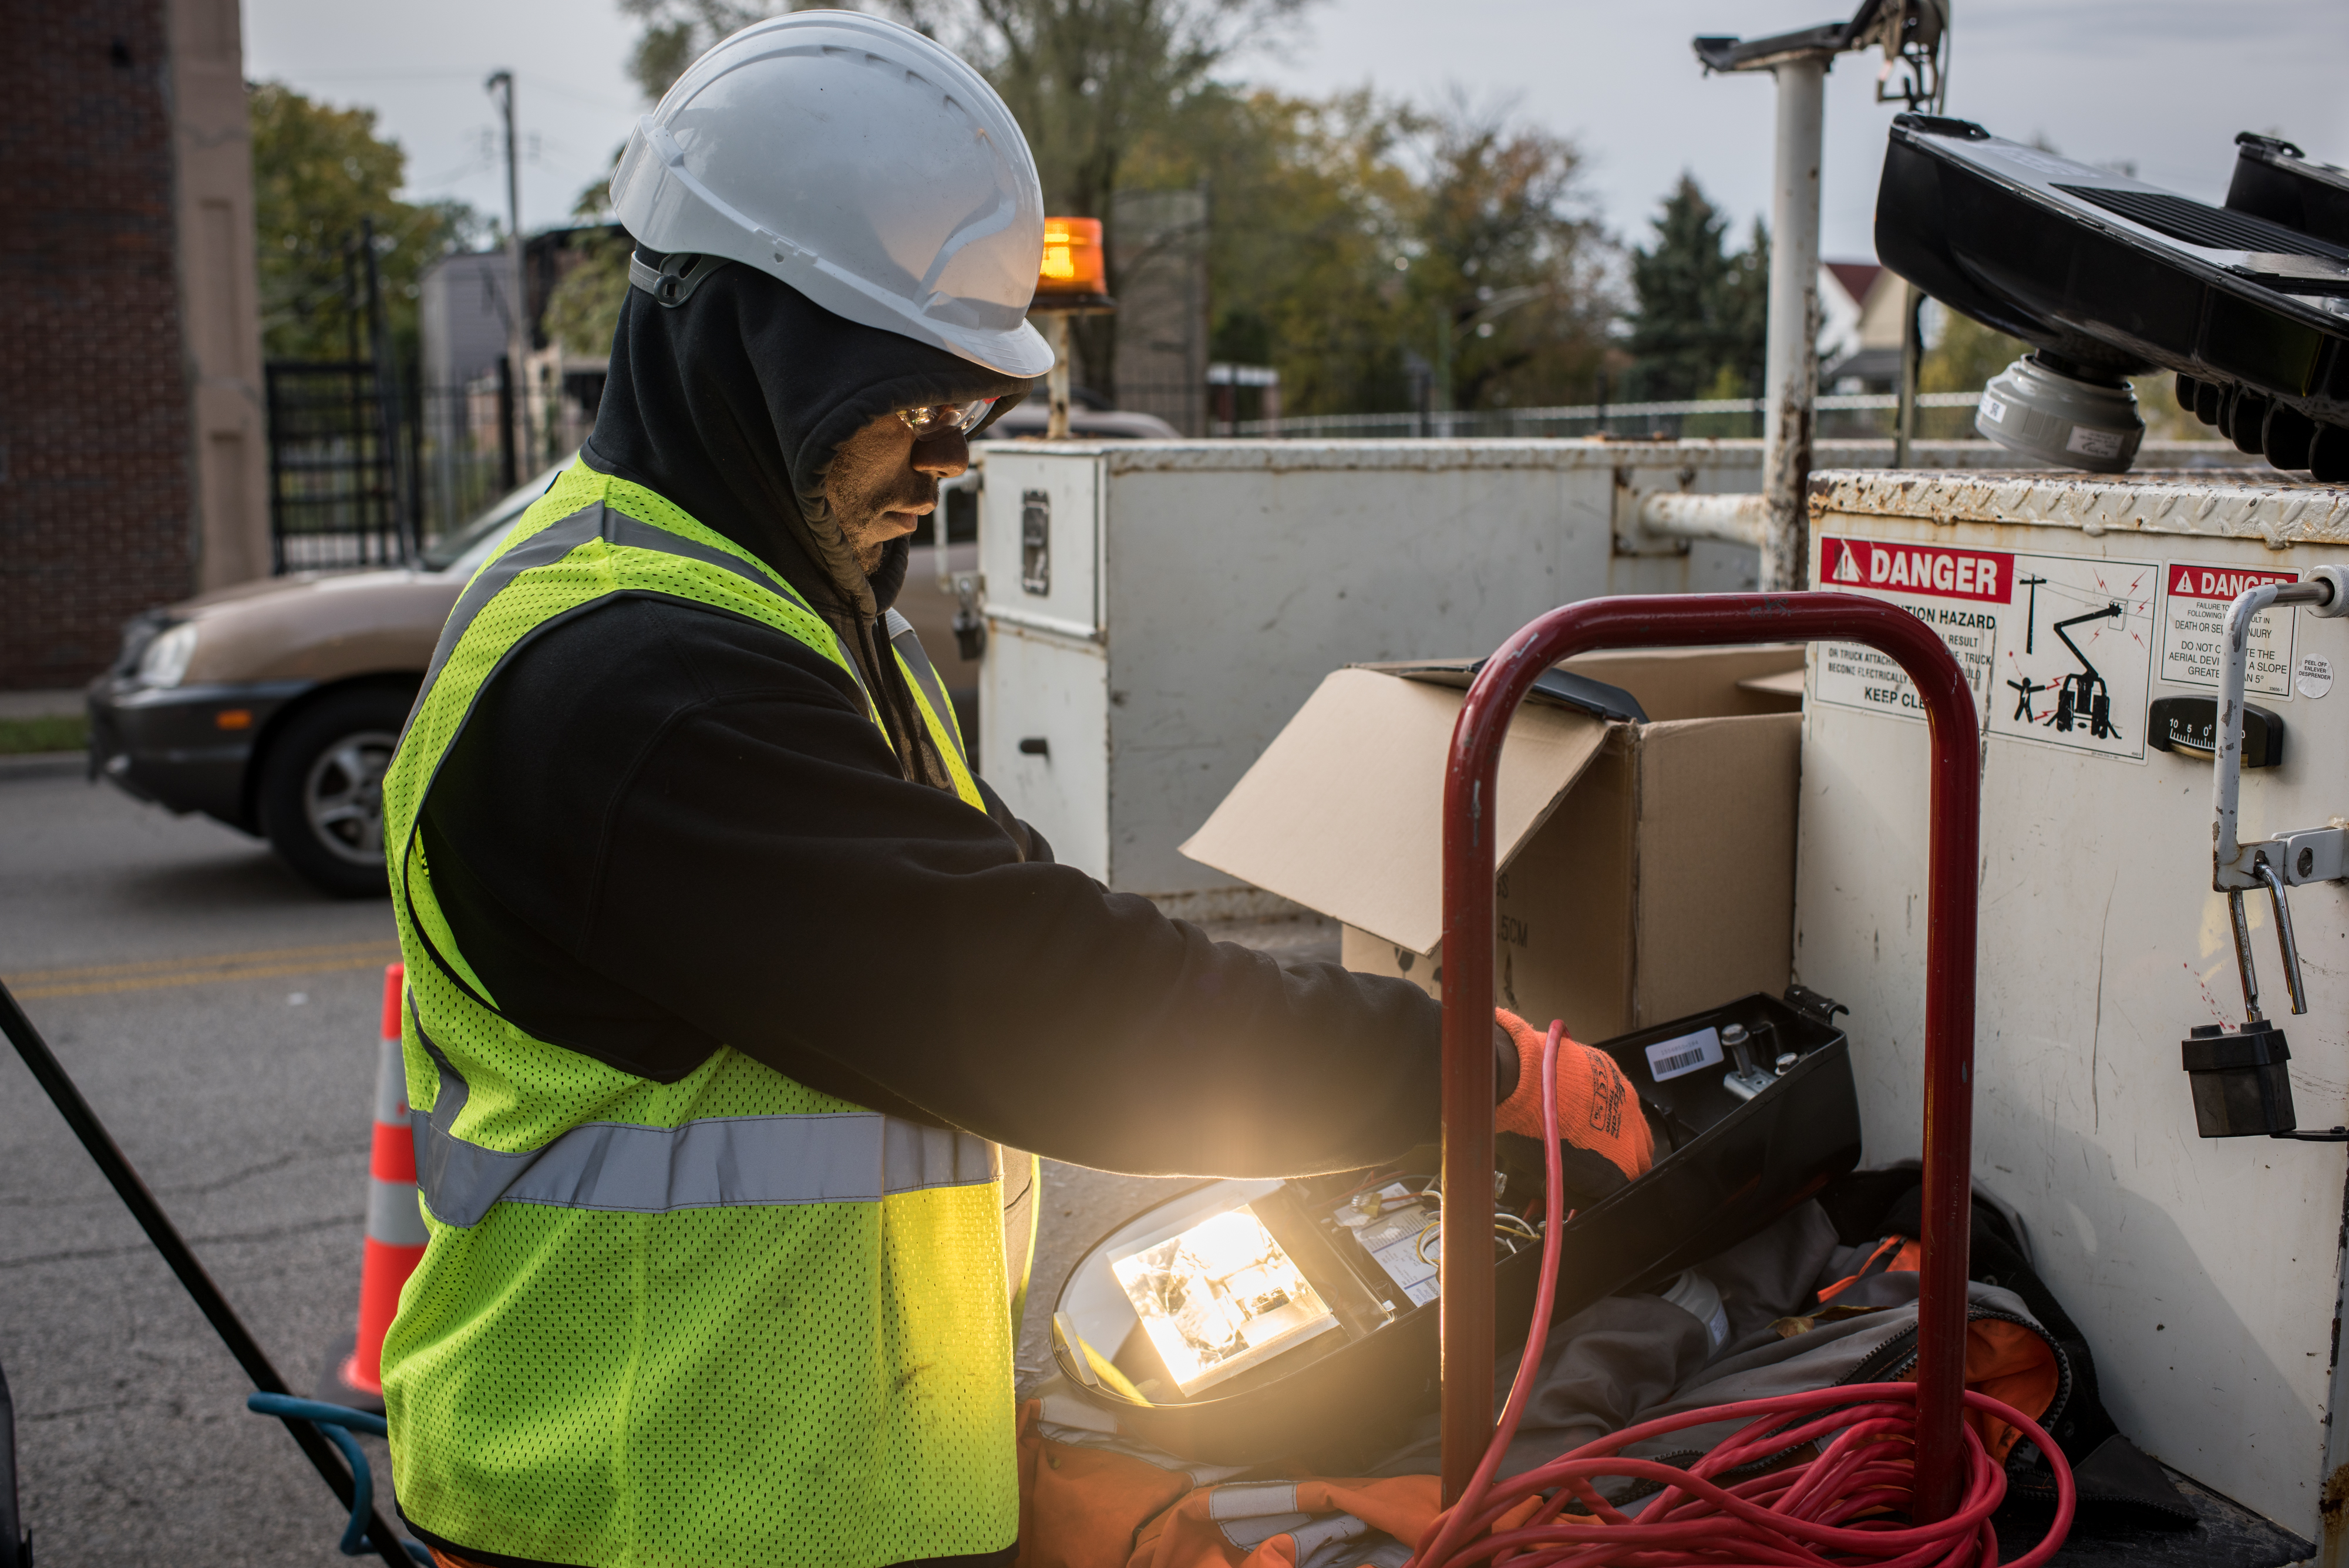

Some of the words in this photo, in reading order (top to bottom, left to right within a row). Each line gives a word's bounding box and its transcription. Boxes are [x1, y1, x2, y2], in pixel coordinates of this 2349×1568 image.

[1870, 549, 1997, 595] DANGER
[2196, 602, 2220, 611] FAILURE
[1940, 610, 1996, 630] HAZARD
[2188, 610, 2222, 620] FOLLOWING
[2175, 620, 2197, 631] DEATH
[2199, 622, 2210, 632] OR
[2247, 628, 2272, 639] NJURY
[1948, 634, 1978, 648] RESULT
[2182, 641, 2193, 650] DO
[2196, 642, 2213, 652] NOT
[1829, 647, 1838, 658] OR
[1840, 650, 1863, 661] TRUCK
[1865, 653, 1901, 668] ATTACHM
[1965, 652, 1992, 665] TRUCK
[2169, 652, 2197, 663] AERIAL
[2200, 655, 2220, 666] DEVI
[2257, 650, 2276, 660] THE
[2188, 667, 2220, 678] GREATE
[2249, 661, 2255, 670] A
[2257, 662, 2287, 674] SLOPE
[2304, 665, 2326, 674] ENLEVER
[2298, 671, 2331, 680] DESPRENDER
[1865, 686, 1897, 704] KEEP
[2169, 718, 2179, 728] 10
[2186, 724, 2192, 733] 5
